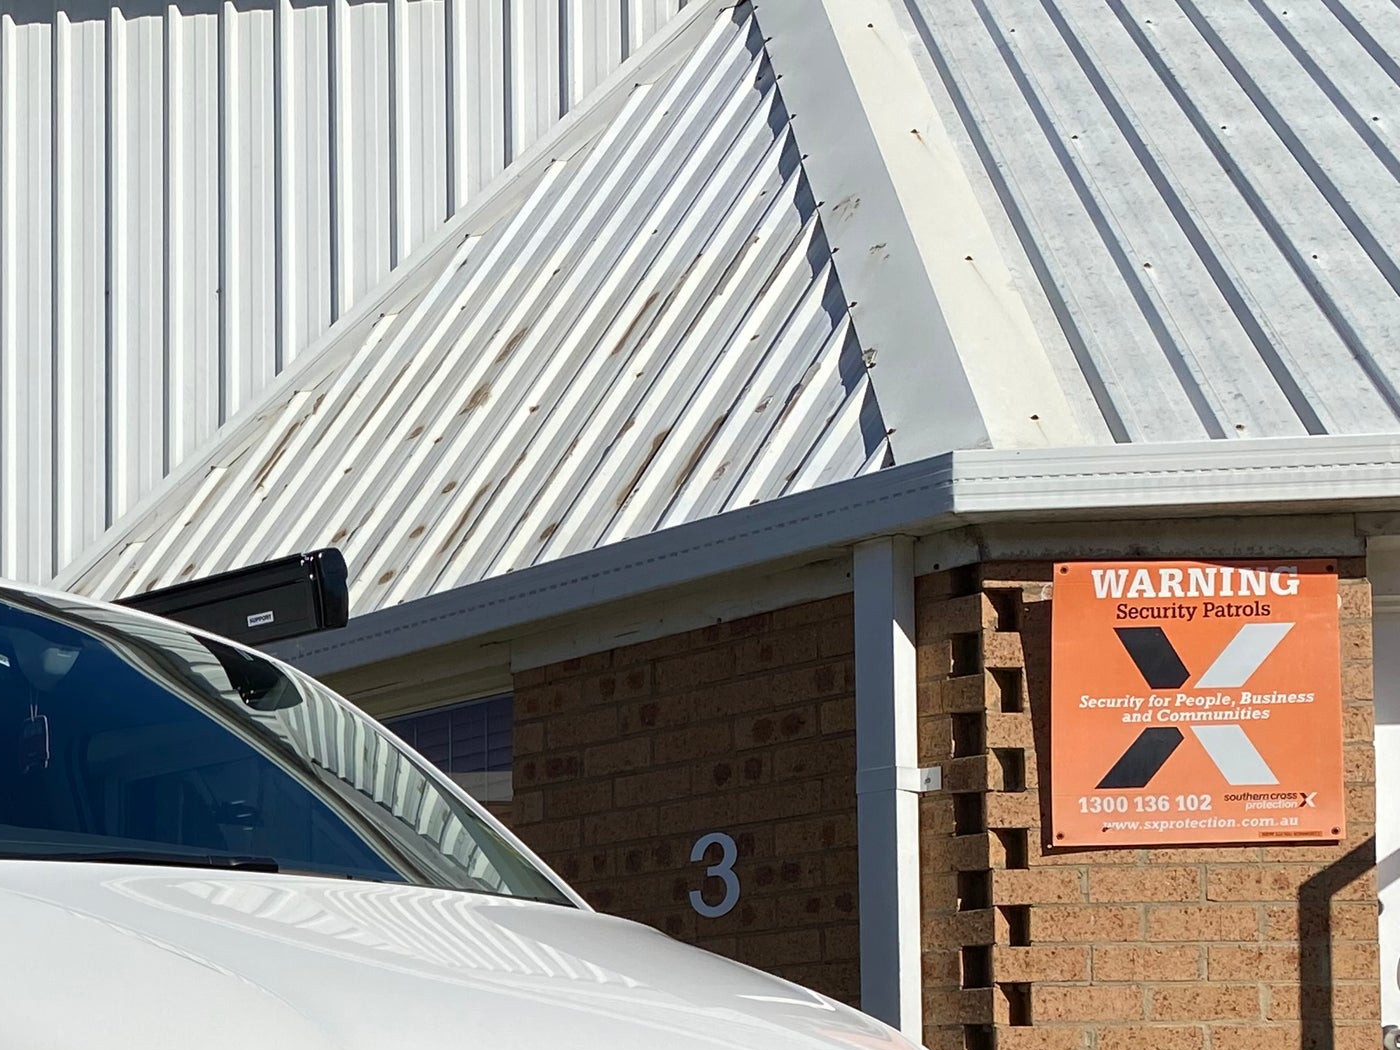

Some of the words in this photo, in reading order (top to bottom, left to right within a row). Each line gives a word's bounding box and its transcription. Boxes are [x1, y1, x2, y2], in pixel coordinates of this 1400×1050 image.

[1090, 565, 1300, 600] WARNING
[1116, 602, 1197, 621] Security
[1202, 600, 1271, 618] Patrols
[1079, 694, 1145, 711] Security
[1148, 693, 1171, 708] for
[1174, 692, 1236, 710] People,
[1239, 690, 1315, 705] Business
[1121, 709, 1153, 723] and
[1156, 707, 1271, 723] Communities
[1077, 796, 1129, 814] 1300
[1133, 795, 1170, 813] 136
[1175, 793, 1213, 812] 102
[1245, 800, 1298, 812] protection
[1102, 816, 1299, 832] www.sxprotection.com.au
[688, 831, 741, 919] 3
